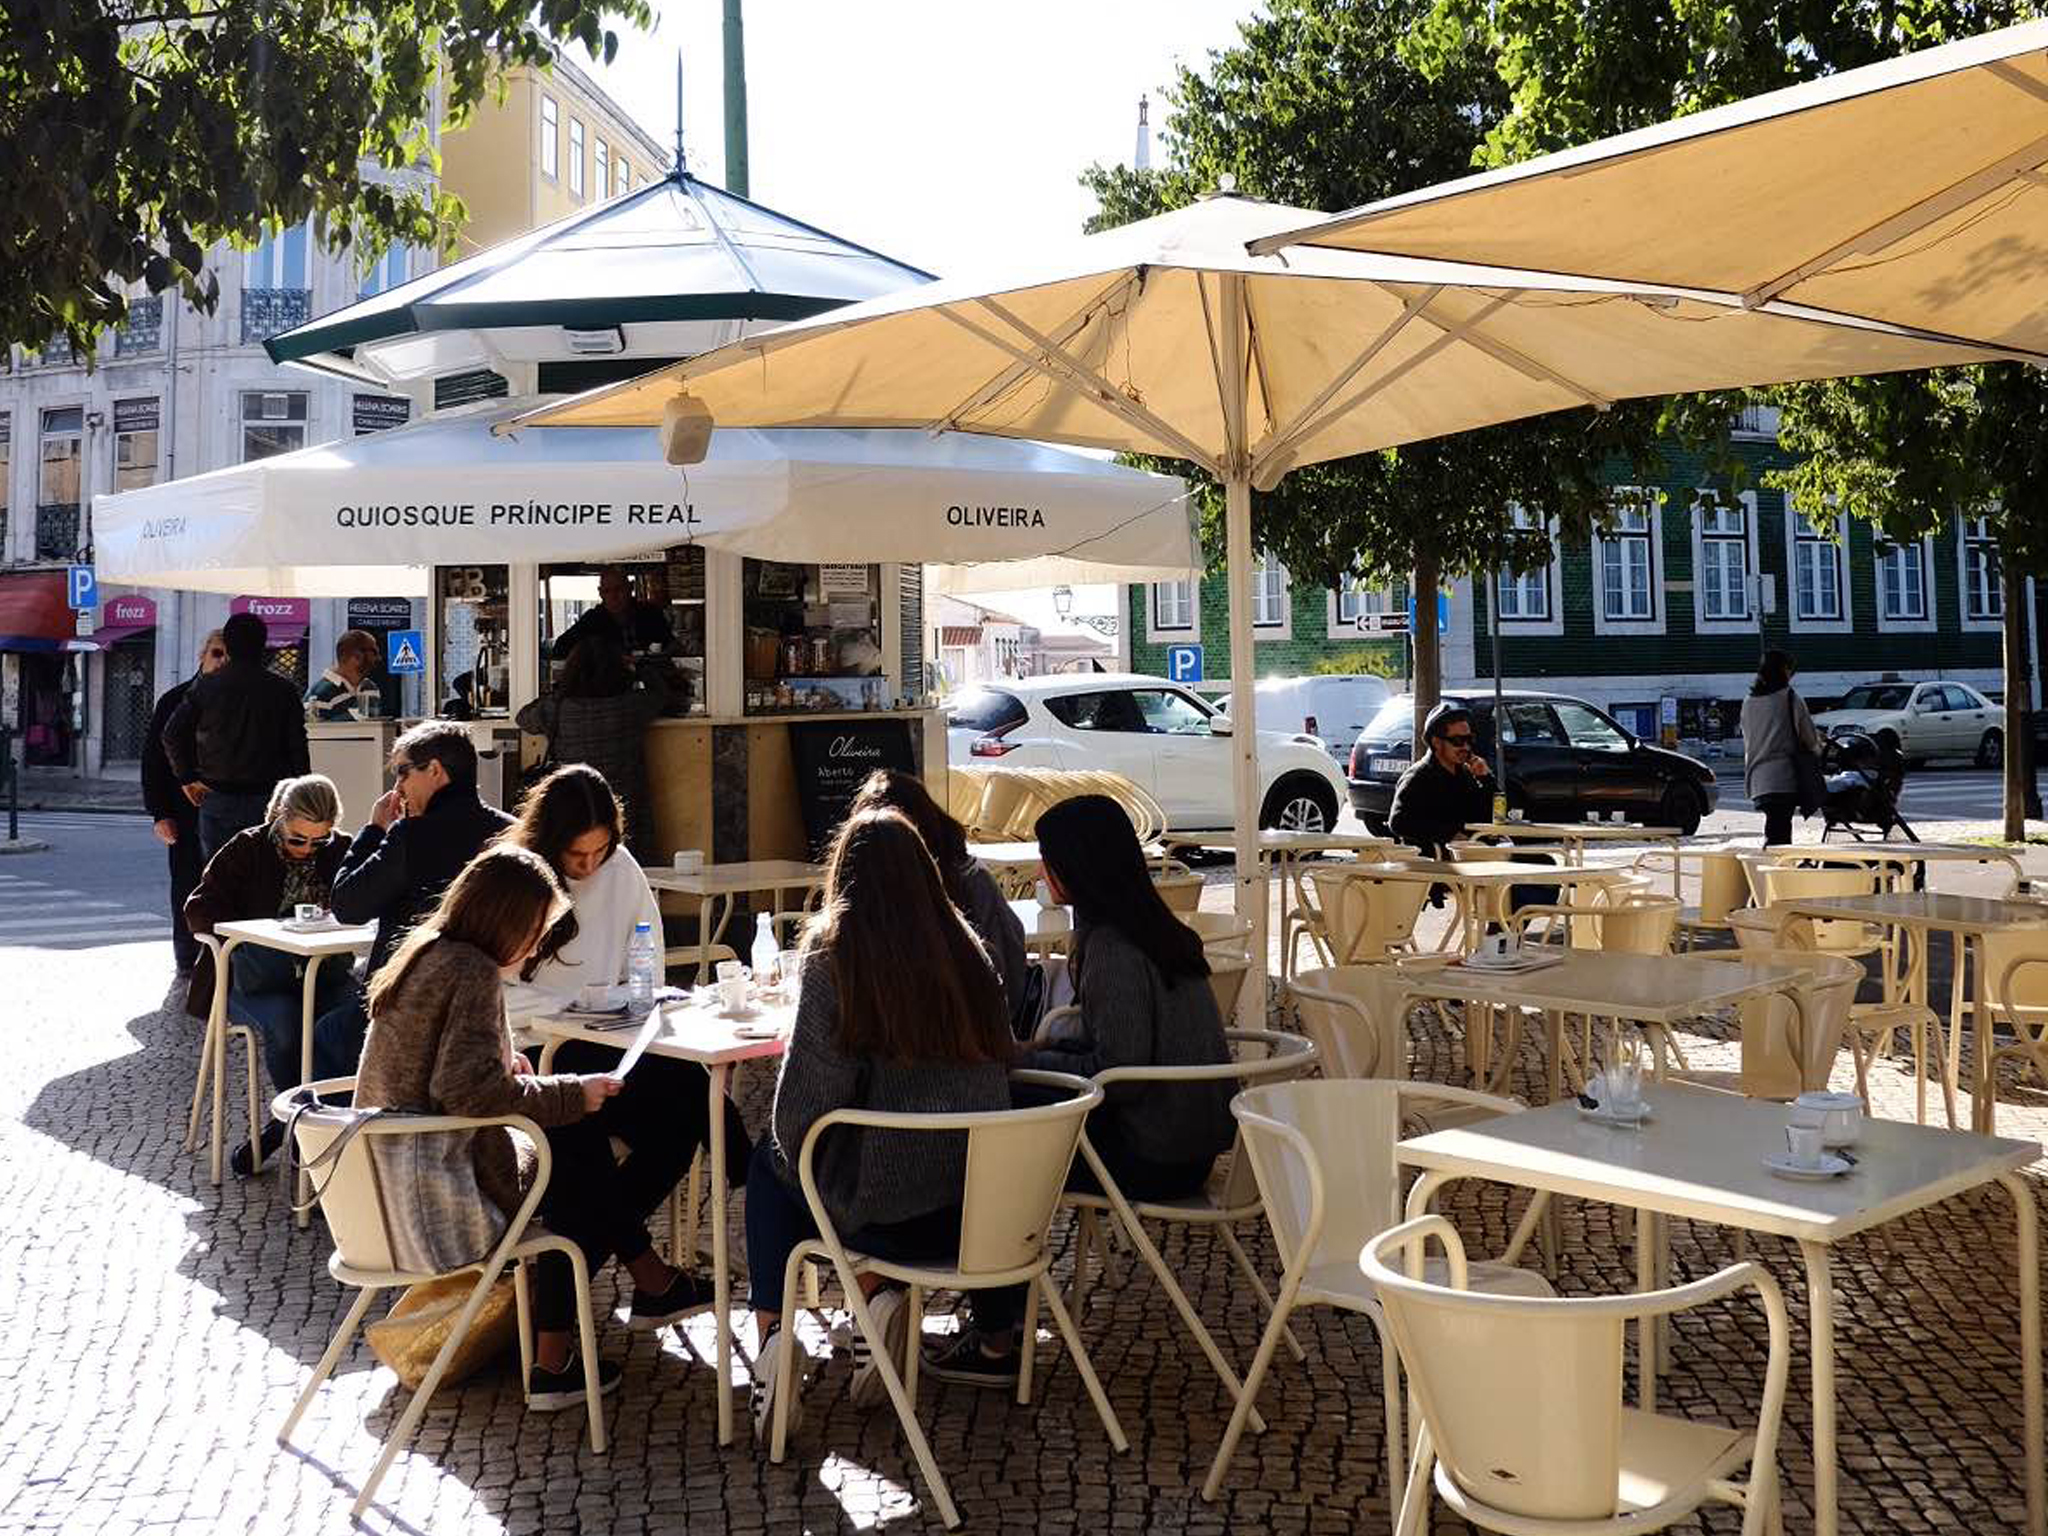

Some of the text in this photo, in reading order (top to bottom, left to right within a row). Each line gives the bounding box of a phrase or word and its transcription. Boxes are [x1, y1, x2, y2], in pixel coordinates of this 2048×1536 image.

[337, 500, 701, 528] QUIOSQUE PRÍNCIPE REAL
[947, 506, 1045, 527] OLIVEIRA
[75, 569, 92, 605] P
[115, 603, 145, 619] frozz
[247, 599, 294, 615] frozz
[1175, 649, 1196, 680] P
[829, 736, 881, 757] Oliveira
